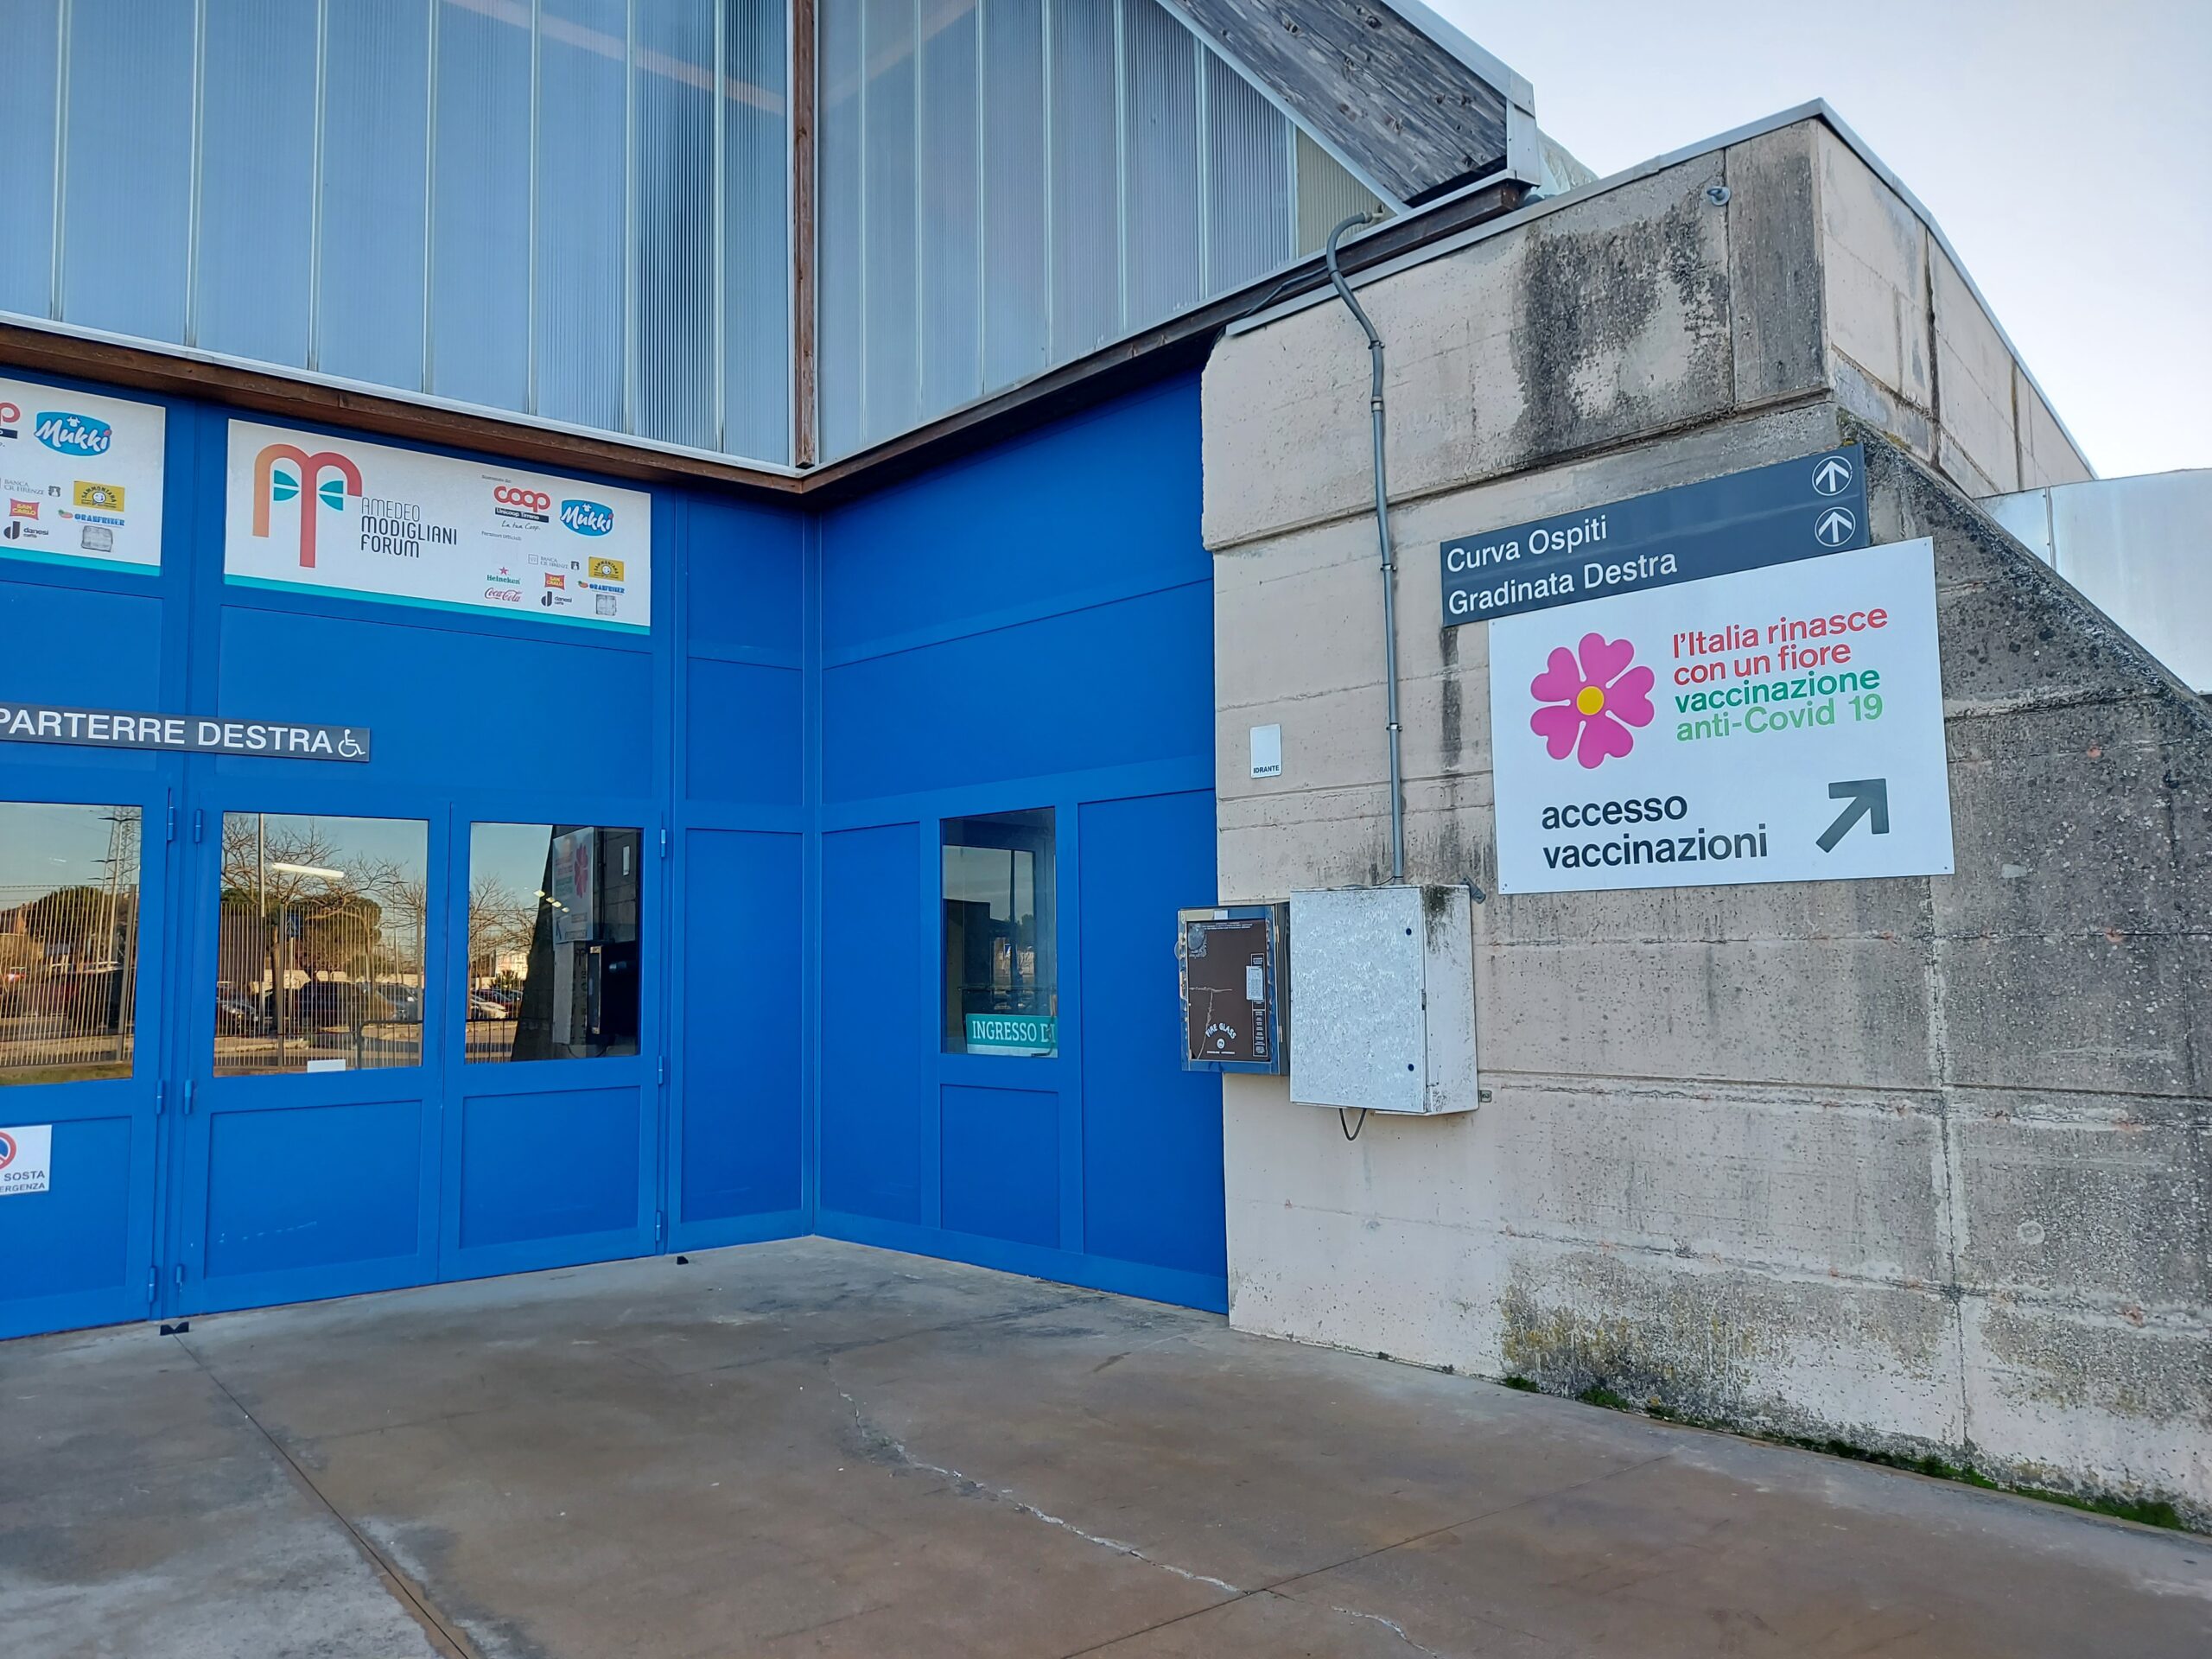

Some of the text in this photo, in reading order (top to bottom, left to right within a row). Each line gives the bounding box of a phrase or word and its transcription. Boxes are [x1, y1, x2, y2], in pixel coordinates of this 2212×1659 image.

[35, 419, 111, 452] Mukki
[4, 479, 29, 487] BANCA
[81, 486, 118, 503] SAMMONTANA
[361, 497, 421, 523] AMEDEO
[493, 486, 551, 513] coop
[23, 527, 49, 536] danesi
[361, 515, 457, 545] MODIGLIANI
[501, 519, 511, 528] La
[512, 521, 523, 530] tua
[561, 505, 614, 532] Mukki
[360, 534, 420, 558] FORUM
[1446, 515, 1607, 574] Curva Ospiti
[486, 575, 520, 585] Heineken
[1448, 553, 1678, 615] Gradinata Destra
[1768, 607, 1888, 645] rinasce
[1674, 643, 1852, 686] con un fiore
[1675, 670, 1881, 713] vaccinazione
[1676, 693, 1884, 741] anti-Covid 19
[198, 721, 334, 754] DESTRA
[1253, 765, 1280, 774] IDRANTE
[1541, 795, 1688, 830] accesso
[1542, 823, 1768, 869] vaccinazioni
[972, 1020, 1037, 1042] INGRESSO
[1205, 1022, 1237, 1039] FIRE GLASS
[3, 1170, 46, 1182] SOSTA
